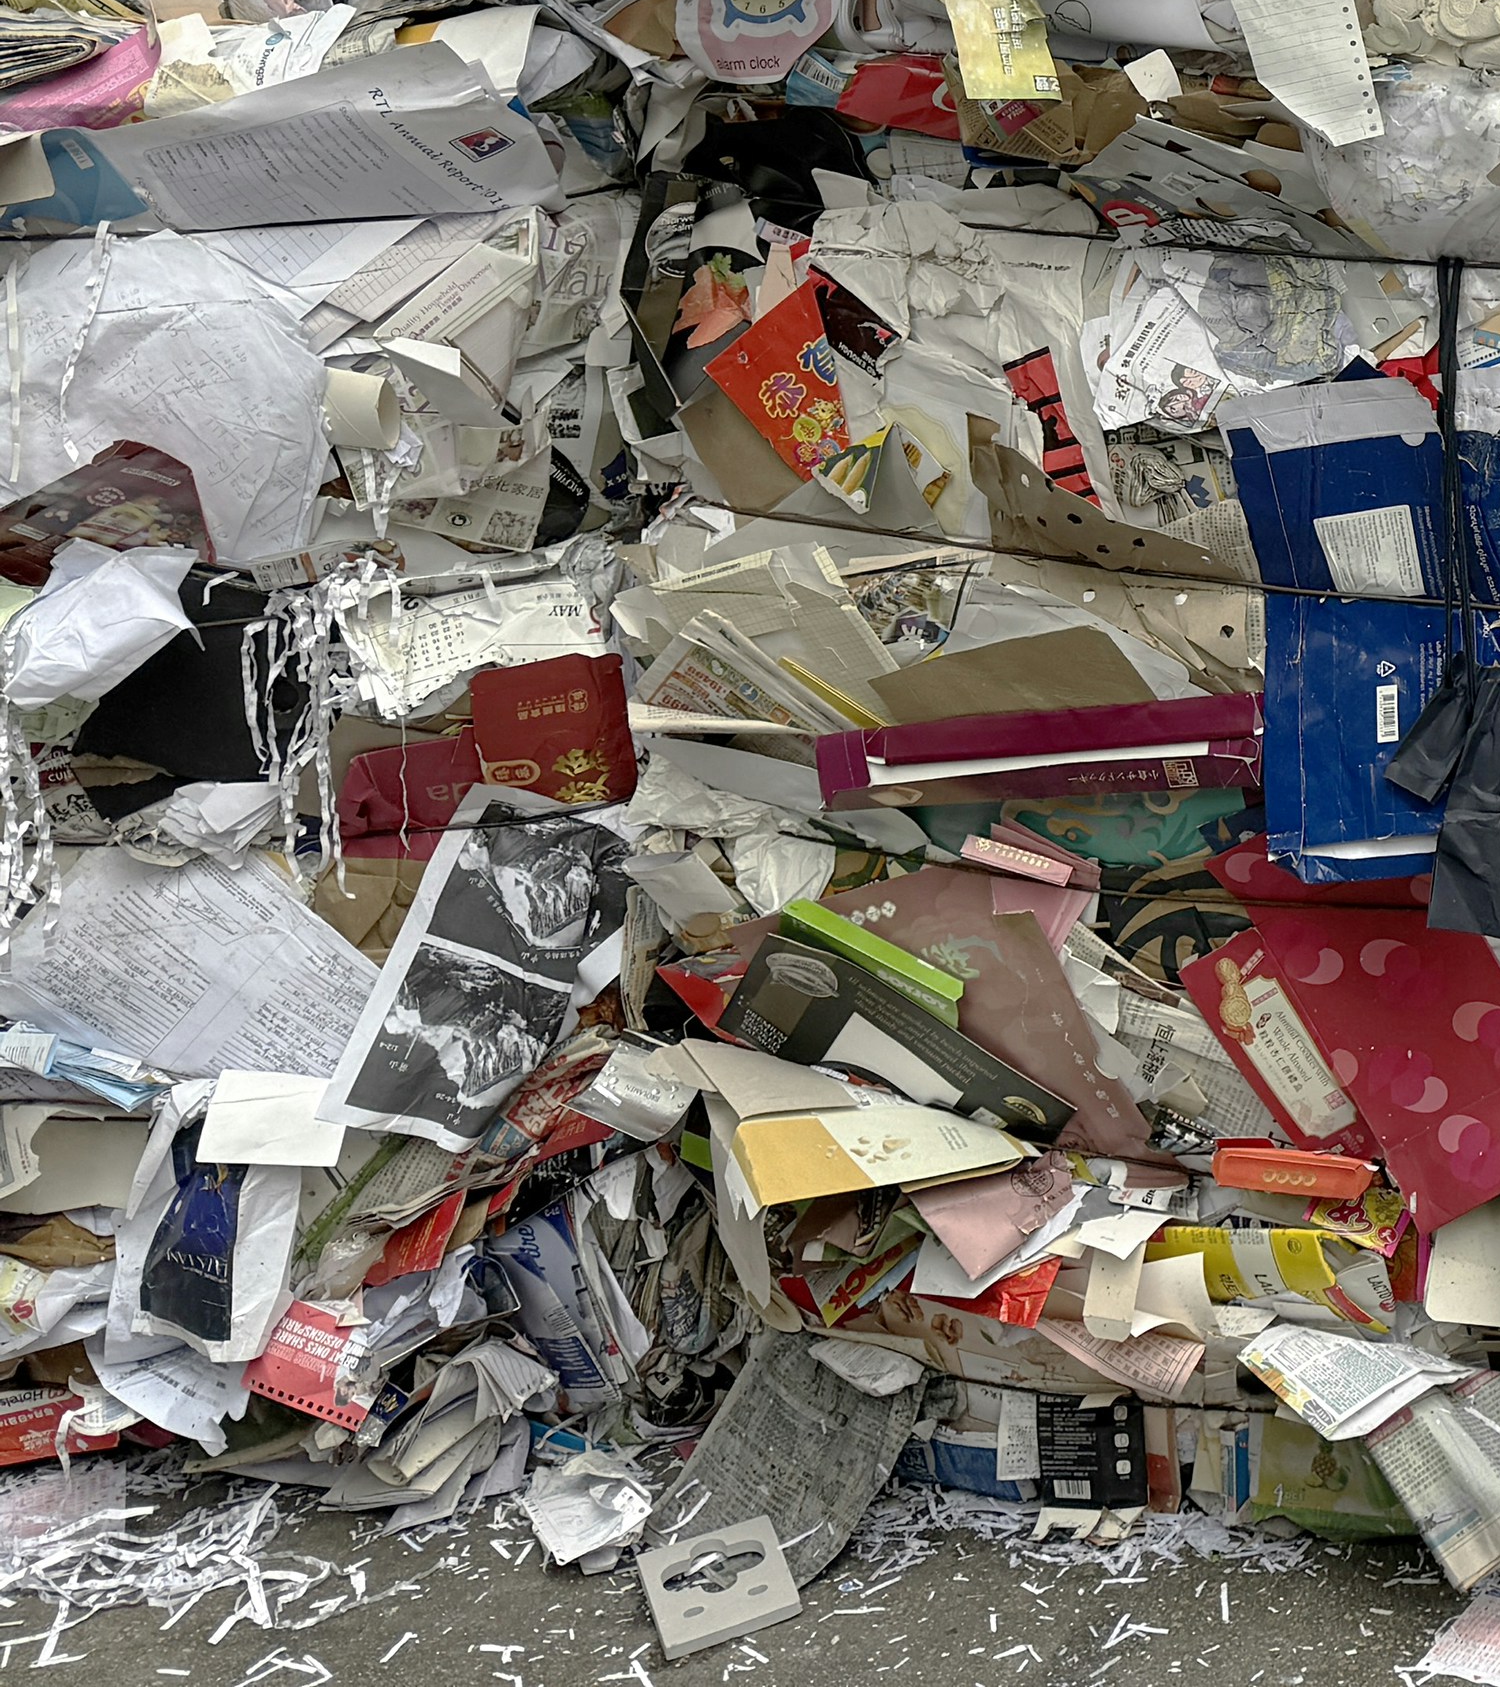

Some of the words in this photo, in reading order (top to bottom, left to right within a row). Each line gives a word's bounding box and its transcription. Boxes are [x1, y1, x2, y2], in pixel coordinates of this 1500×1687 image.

[255, 45, 276, 87] Towngas
[749, 55, 780, 71] clock
[367, 87, 394, 120] RTL
[390, 120, 439, 163] Annual
[438, 159, 484, 195] Report
[390, 314, 422, 338] Quality
[548, 604, 583, 617] MAY
[1066, 768, 1160, 785] 小倉サンドクッキー
[1289, 1052, 1312, 1083] Almond
[1296, 1038, 1318, 1072] Cookies
